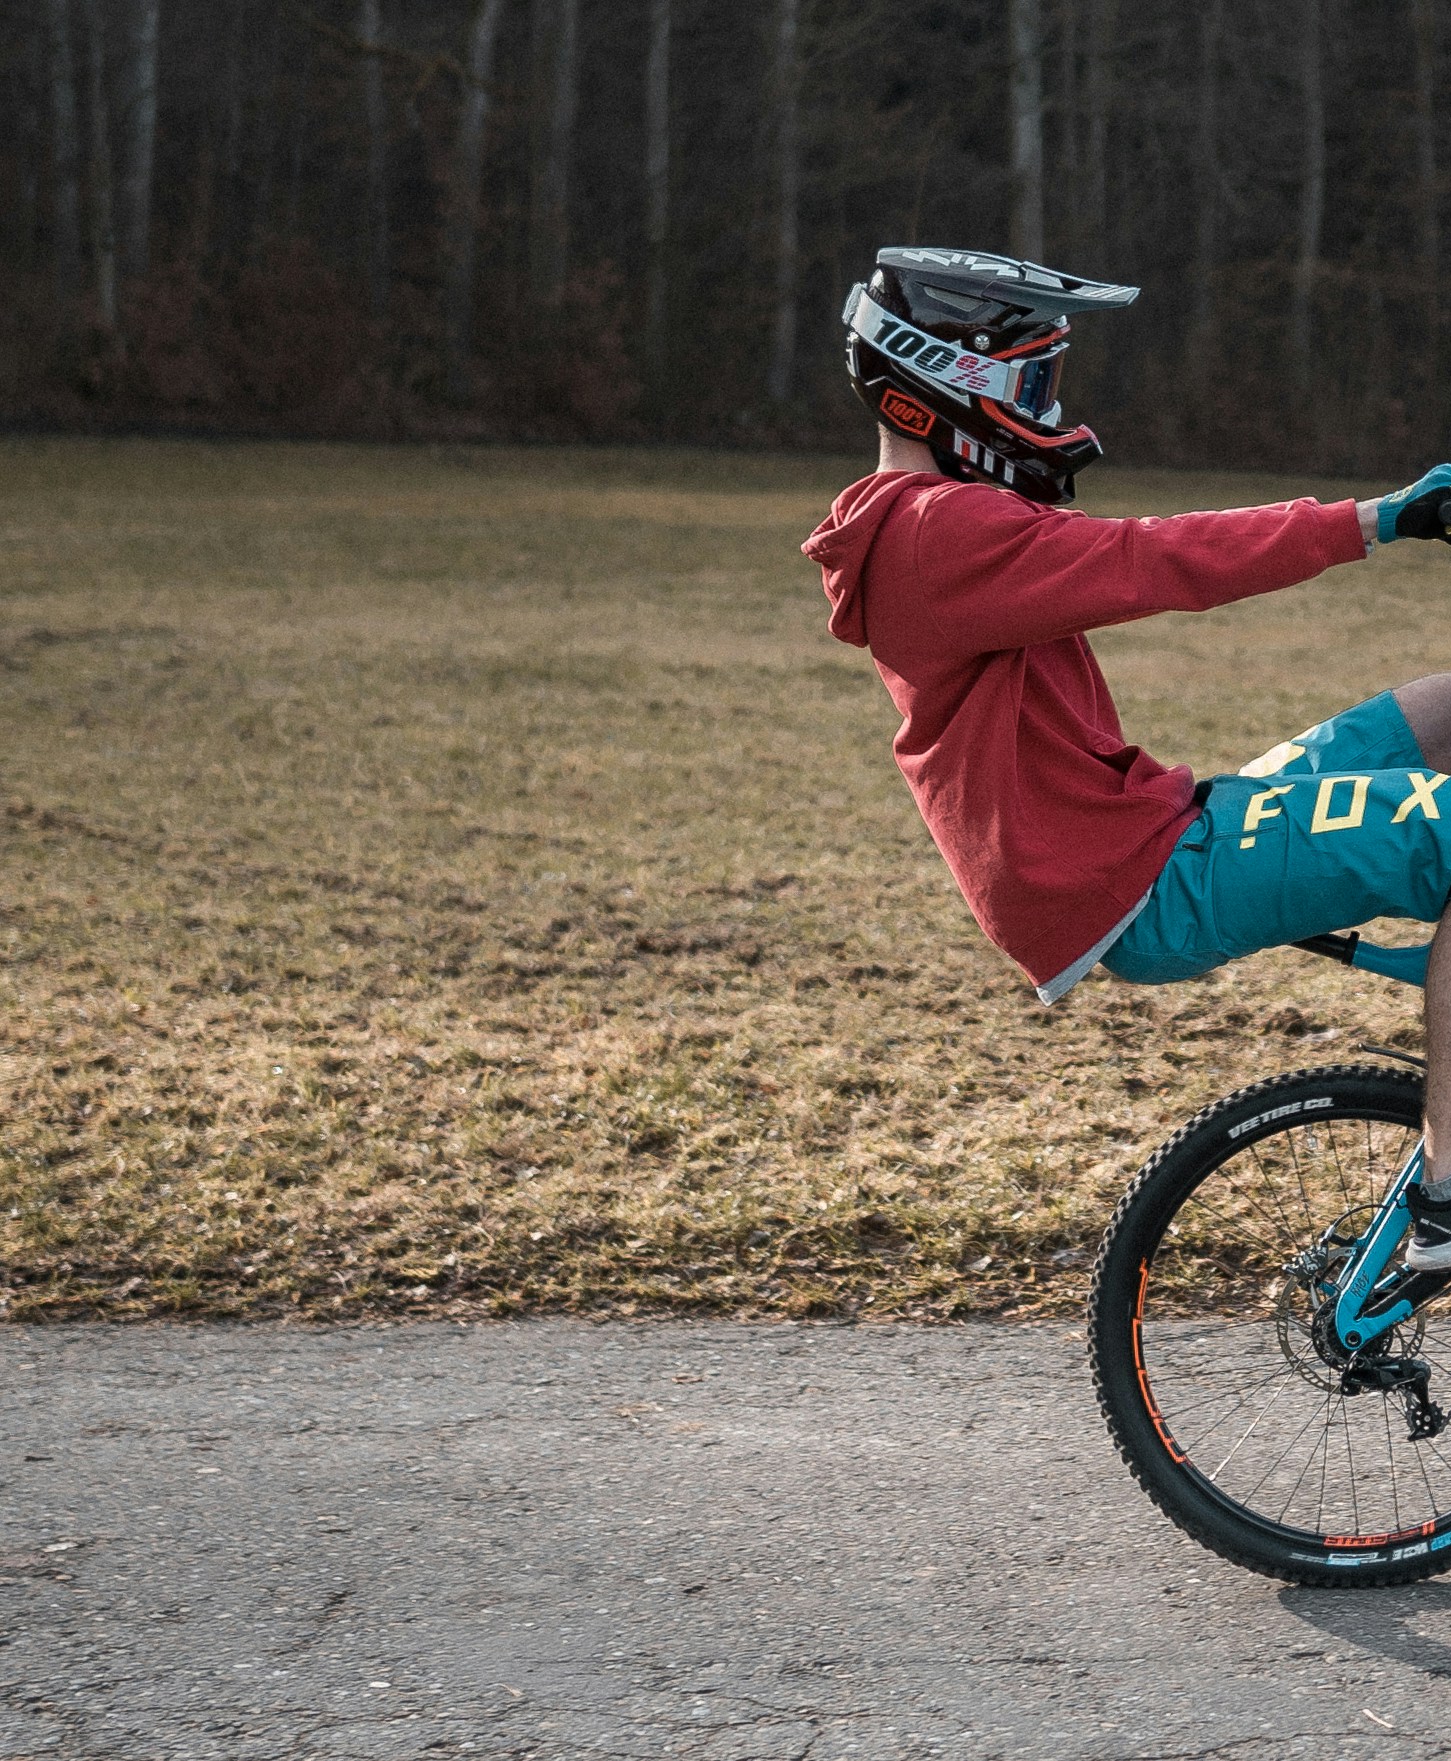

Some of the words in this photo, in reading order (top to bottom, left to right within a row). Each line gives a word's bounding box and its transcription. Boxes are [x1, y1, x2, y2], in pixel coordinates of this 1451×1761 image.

[873, 317, 997, 392] 100%
[886, 398, 932, 430] 100%
[1240, 773, 1451, 850] FOX
[1228, 1116, 1260, 1139] VEE
[1260, 1101, 1303, 1124] TIRE
